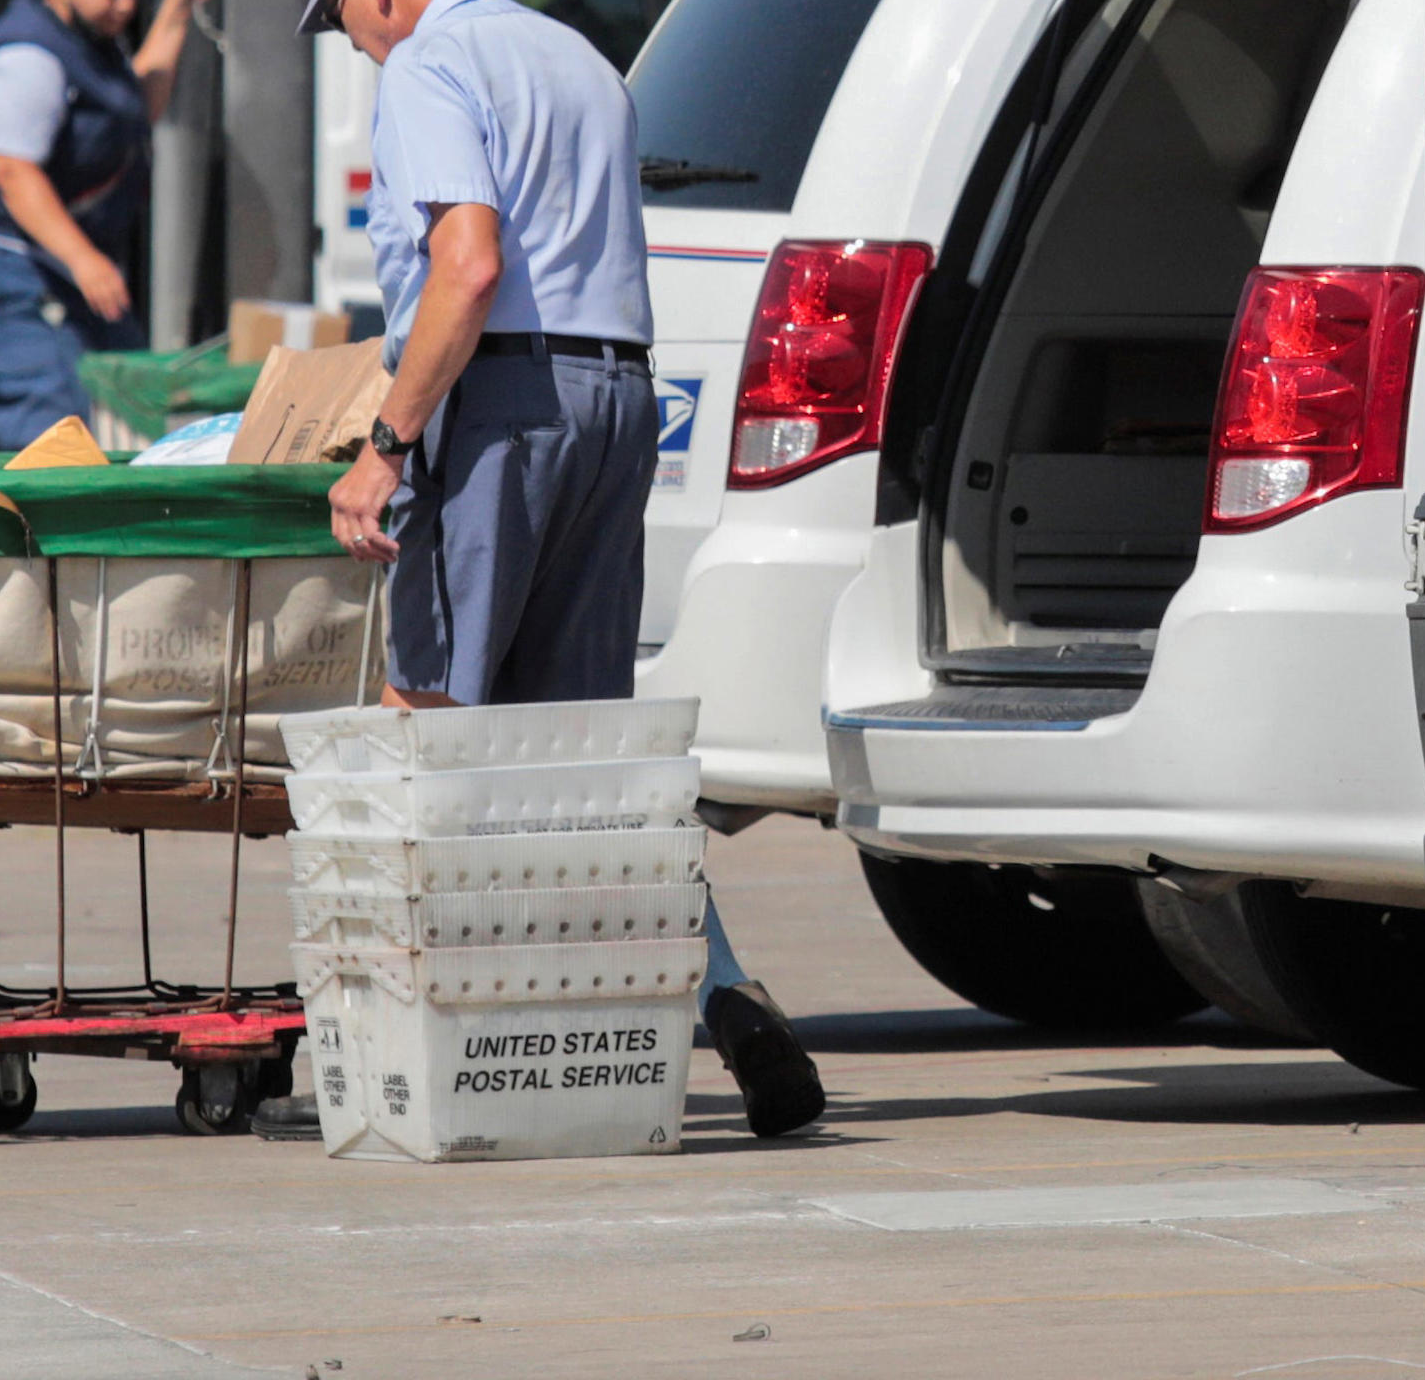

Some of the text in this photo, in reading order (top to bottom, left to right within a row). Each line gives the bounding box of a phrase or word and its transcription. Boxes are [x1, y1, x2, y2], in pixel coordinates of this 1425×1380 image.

[464, 1028, 658, 1059] UNITED STATES
[322, 1065, 345, 1078] LABEL
[453, 1062, 668, 1093] POSTAL SERVICE
[323, 1080, 347, 1093] OTHER
[382, 1073, 409, 1088] LABEL
[329, 1094, 344, 1107] END
[383, 1088, 411, 1102] OTHER
[389, 1102, 407, 1115] END
